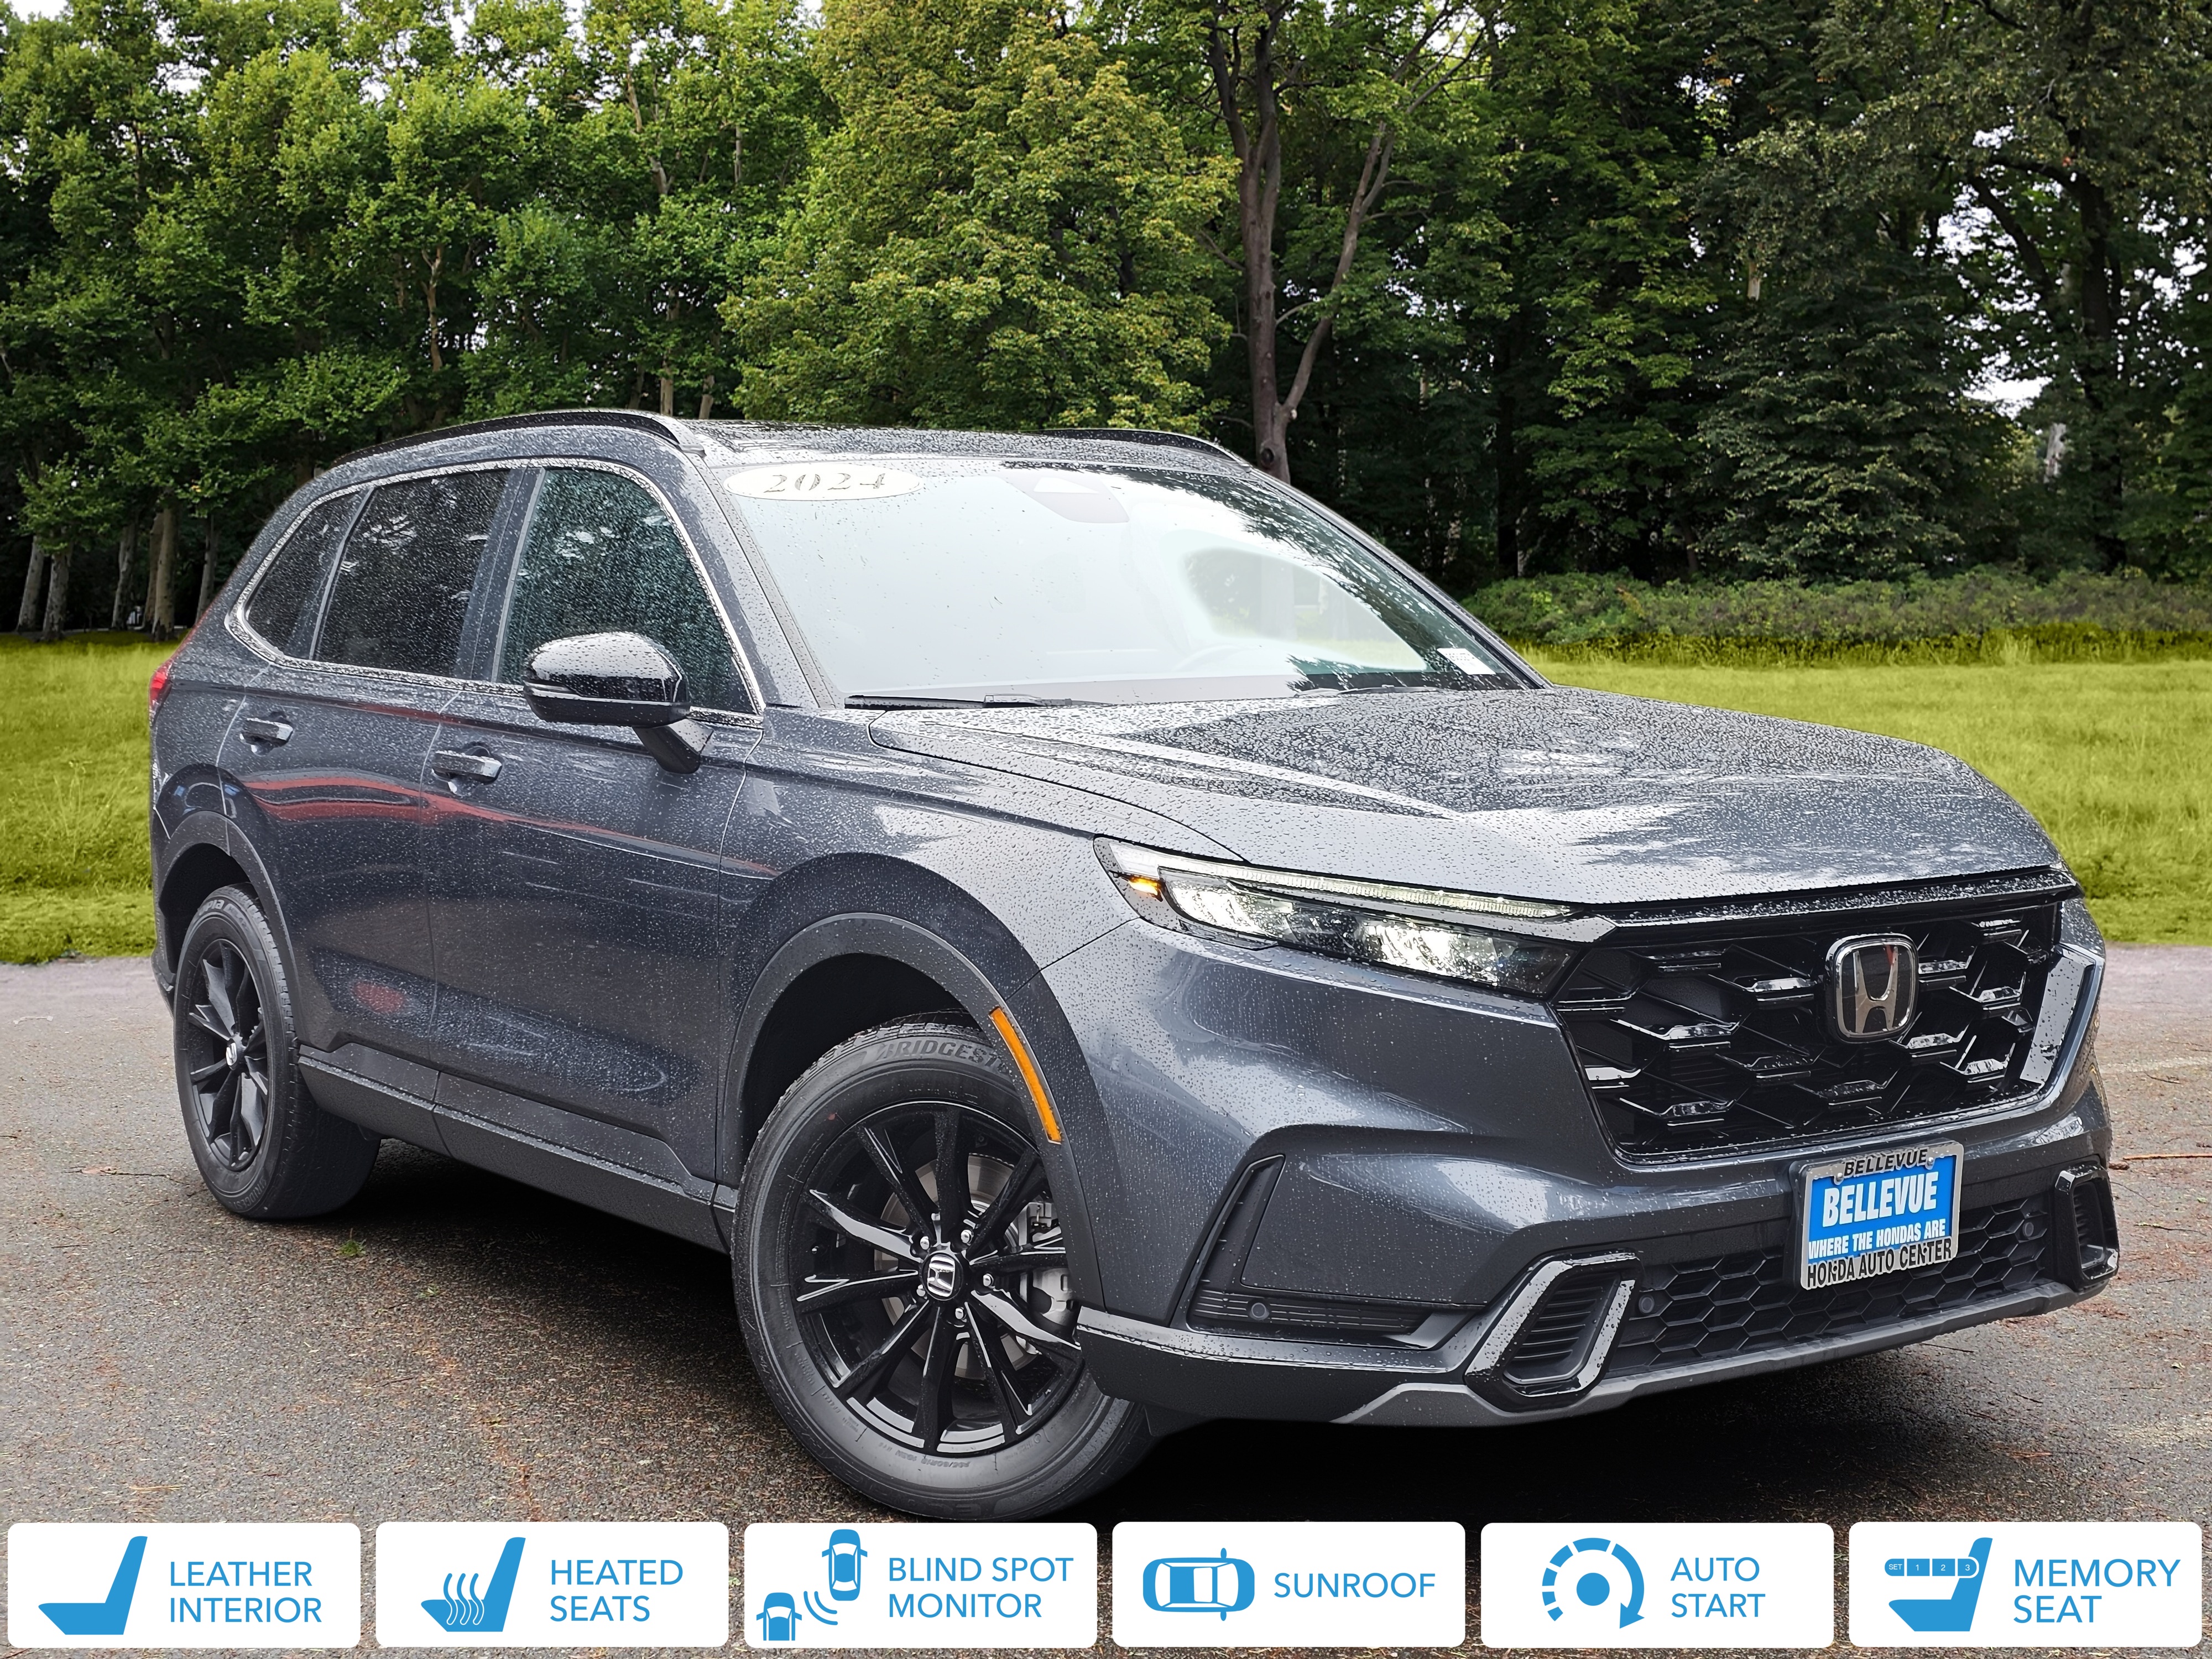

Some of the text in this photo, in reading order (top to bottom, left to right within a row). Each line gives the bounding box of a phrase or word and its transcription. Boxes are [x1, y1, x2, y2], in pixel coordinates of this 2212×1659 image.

[763, 473, 885, 493] 2024
[1844, 1149, 1928, 1177] BELLEVUE
[1822, 1171, 1939, 1228] BELLEVUE
[1808, 1218, 1946, 1260] WHERE THE HONDAS ARE
[1807, 1238, 1953, 1288] HONDA AUTO CENTER
